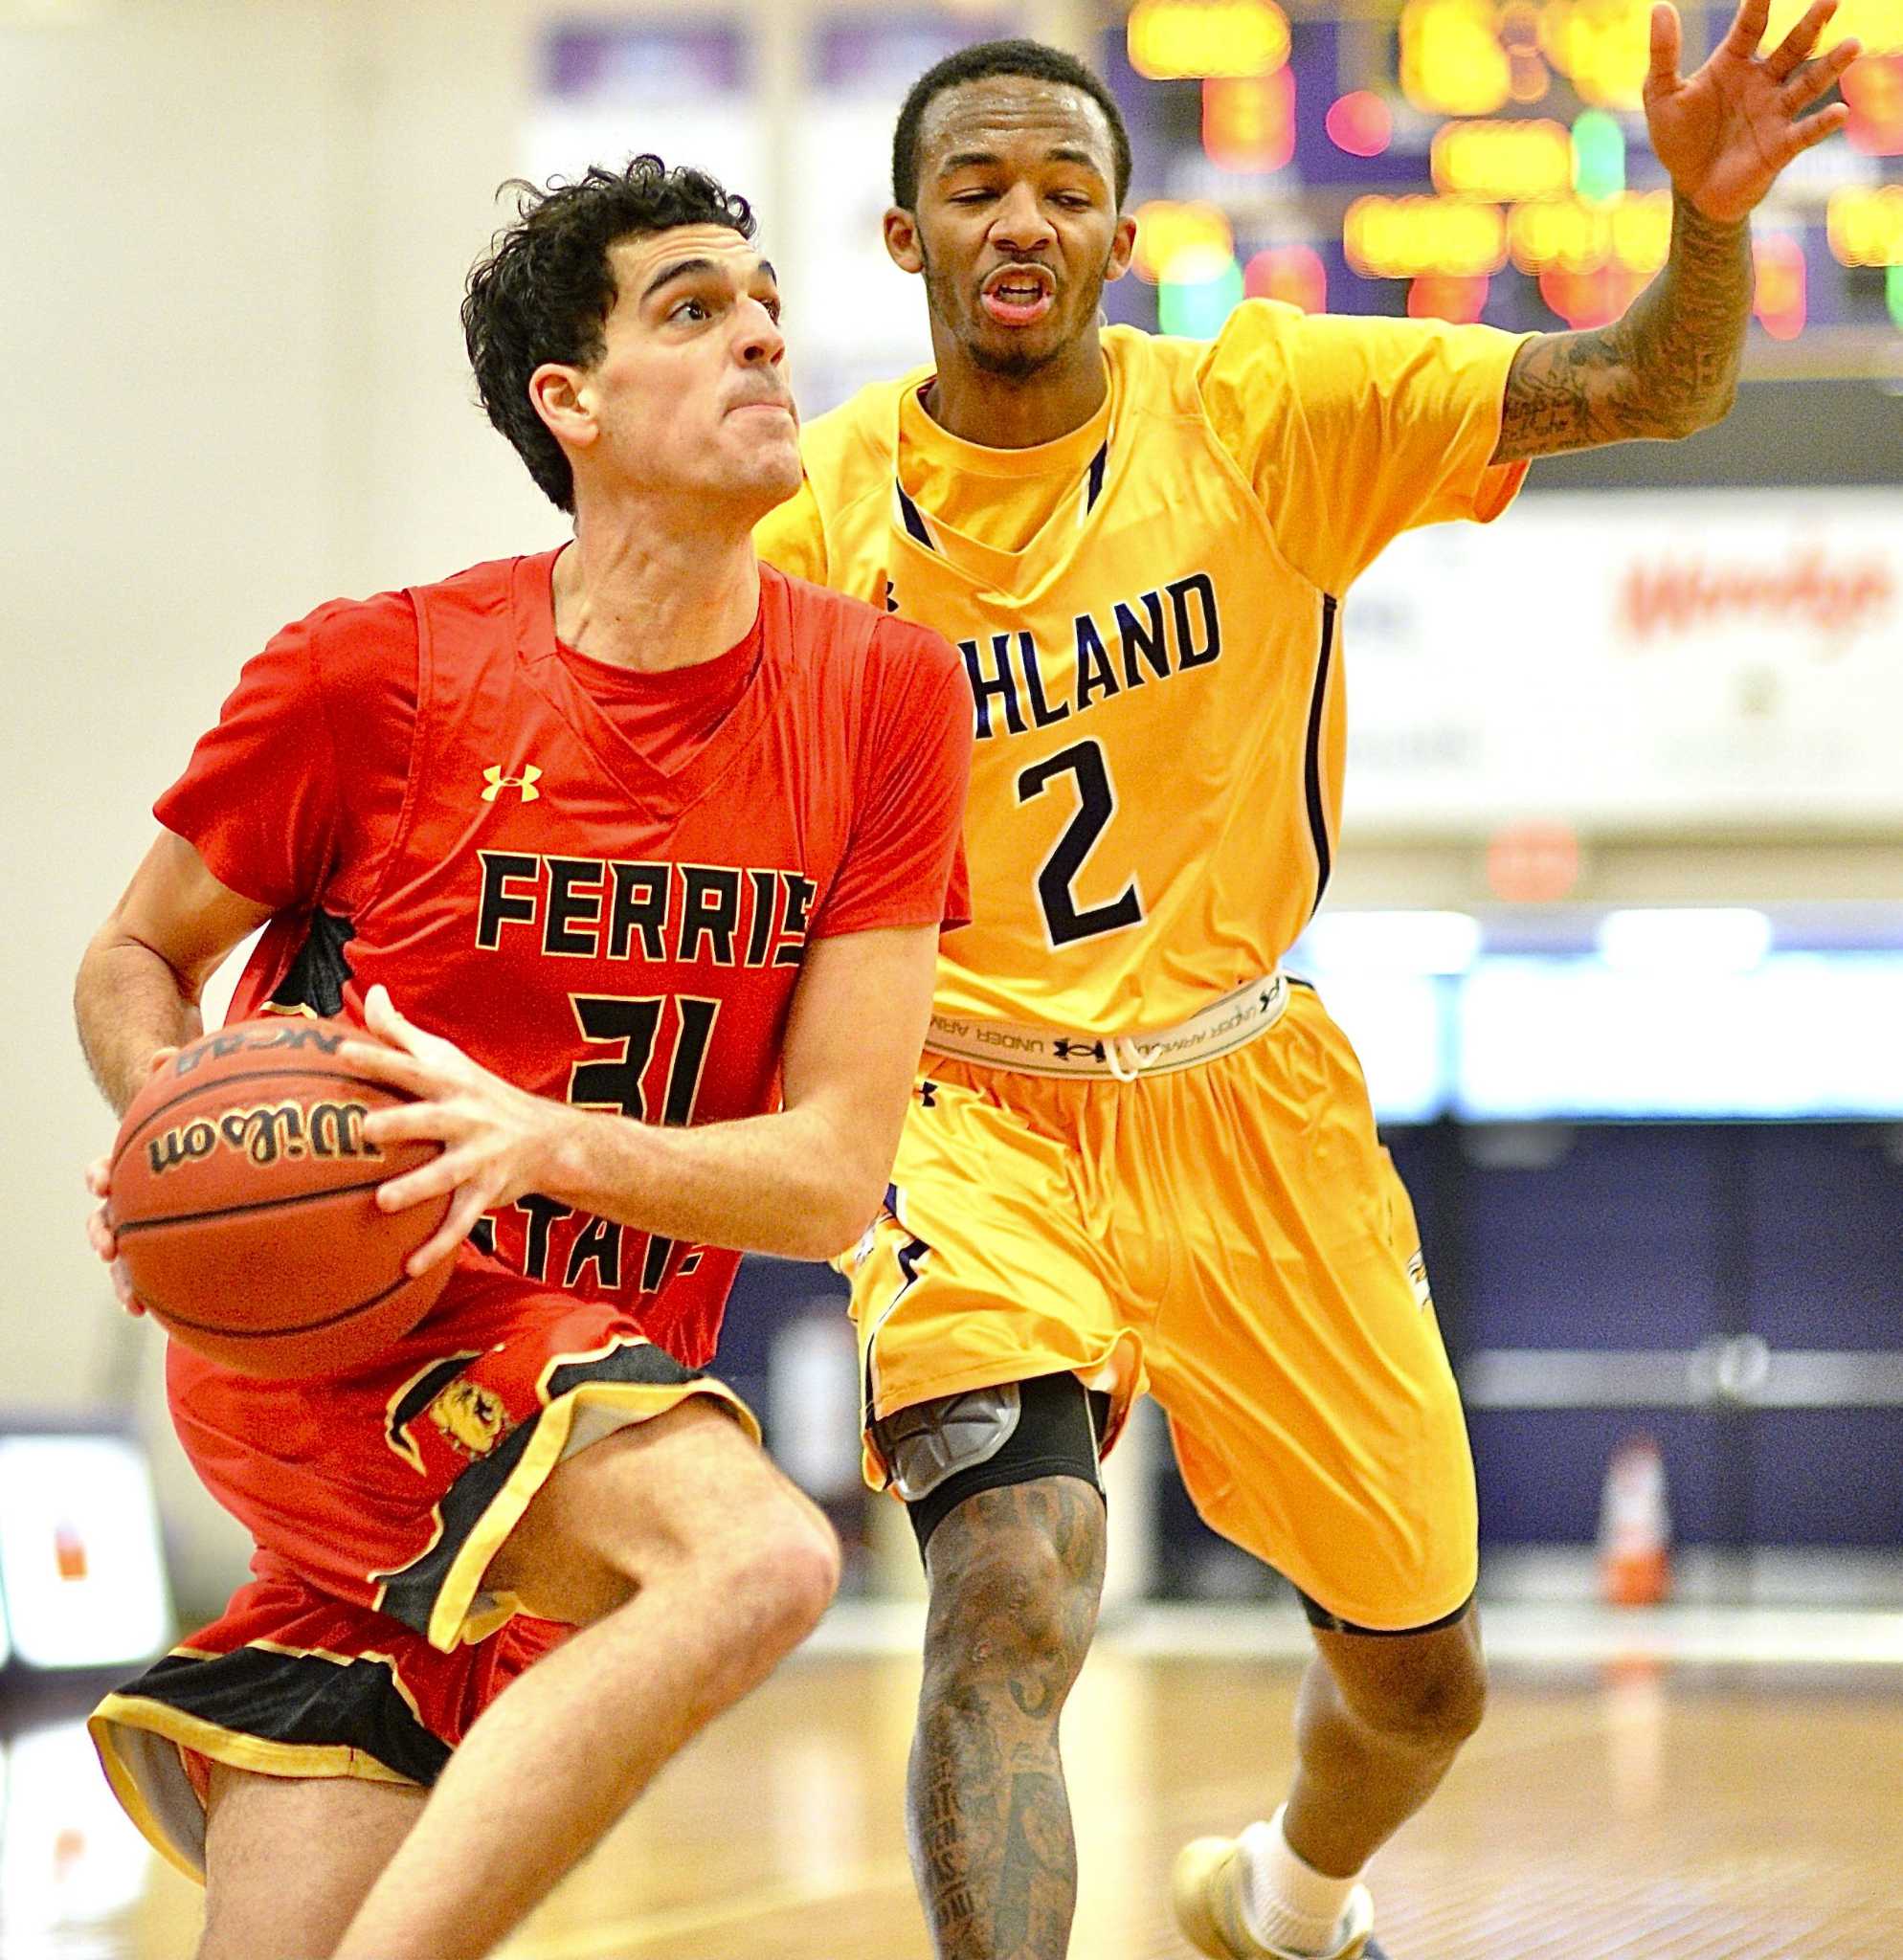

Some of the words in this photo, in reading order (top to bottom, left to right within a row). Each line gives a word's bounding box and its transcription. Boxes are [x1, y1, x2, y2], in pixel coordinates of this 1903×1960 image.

[957, 572, 1221, 741] HLAND
[1014, 738, 1148, 952] 2
[476, 850, 818, 968] FERRIS
[567, 991, 723, 1128] 31
[929, 1014, 970, 1036] ARM
[976, 1028, 1044, 1054] UNDER
[147, 1100, 385, 1177] Wilson
